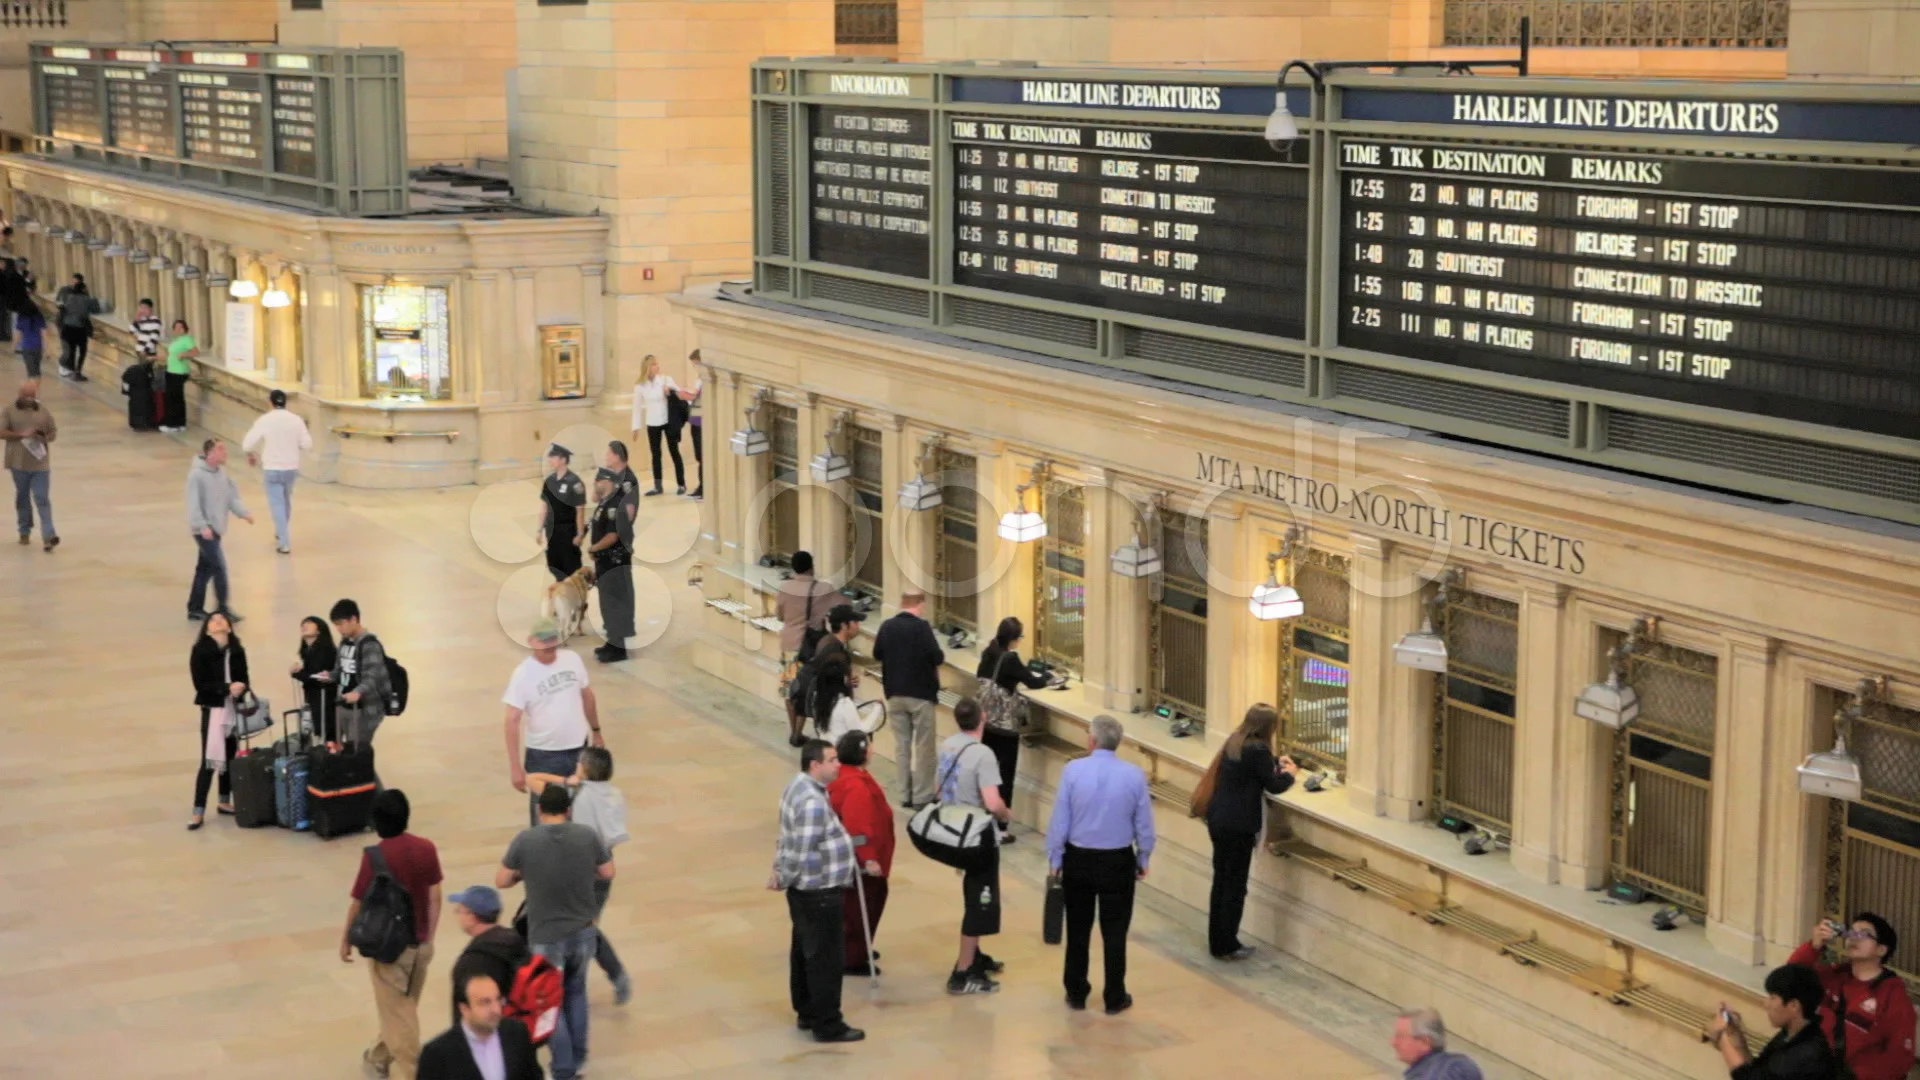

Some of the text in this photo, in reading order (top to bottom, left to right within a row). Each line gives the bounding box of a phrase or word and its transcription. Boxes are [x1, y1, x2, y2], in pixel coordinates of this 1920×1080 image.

[831, 75, 909, 96] INFORMATION
[1023, 81, 1221, 110] HARLEM LINE DEPARTURES
[1453, 95, 1779, 134] HARLEM LINE DEPARTURES
[954, 122, 1152, 150] TIME TRK DESTINATION REMARKS
[1048, 156, 1078, 172] PLAINS
[1101, 159, 1139, 178] MELROSE
[1155, 164, 1171, 181] 1ST
[1175, 165, 1199, 183] STOP
[1344, 144, 1662, 185] TIME TRK DESTINATION REMARKS
[1015, 180, 1059, 198] SOUTHEAST
[1101, 188, 1155, 209] CONNECTION
[1159, 193, 1170, 210] TO
[1351, 179, 1384, 199] 12:55
[1410, 183, 1425, 202] 23
[1438, 185, 1459, 205] NO.
[1467, 187, 1484, 208] WH
[1490, 188, 1538, 212] PLAINS
[1577, 196, 1638, 220] FORDHAM
[1665, 202, 1691, 225] 1ST
[1699, 204, 1739, 229] STOP
[1048, 209, 1078, 228] PLAINS
[1154, 221, 1170, 238] 1ST
[1174, 223, 1198, 241] STOP
[1356, 211, 1384, 231] 1:25
[1409, 216, 1425, 236] 30
[1437, 218, 1458, 239] NO.
[1466, 221, 1483, 241] WH
[1489, 222, 1538, 247] PLAINS
[1575, 232, 1637, 257] MELROSE
[1663, 239, 1690, 263] 1ST
[1697, 242, 1737, 266] STOP
[1048, 236, 1078, 255] PLAINS
[1154, 250, 1170, 267] 1ST
[1174, 252, 1198, 271] STOP
[1015, 259, 1058, 279] SOUTHEAST
[1100, 270, 1127, 290] WHITE
[1131, 275, 1164, 295] PLAINS
[1180, 282, 1197, 300] 1ST
[1201, 284, 1226, 304] STOP
[1355, 243, 1763, 307] 1:48 28 SOUTHEAST CONNECTION TO WASSAIC
[1354, 274, 1382, 295] 1:55
[1402, 281, 1423, 301] 106
[1435, 285, 1456, 306] NO.
[1464, 288, 1481, 309] WH
[1487, 291, 1534, 316] PLAINS
[1572, 302, 1633, 329] FORDHAM
[1660, 313, 1686, 336] 1ST
[1694, 317, 1733, 342] STOP
[1352, 306, 1381, 327] 2:25
[1401, 313, 1420, 333] 111
[1435, 318, 1455, 339] NO.
[1464, 321, 1480, 342] WH
[1486, 325, 1533, 350] PLAINS
[1571, 338, 1632, 365] FORDHAM
[1659, 350, 1684, 372] 1ST
[1692, 354, 1731, 380] STOP
[1196, 452, 1586, 575] MTA METRO-NORTH TICKETS
